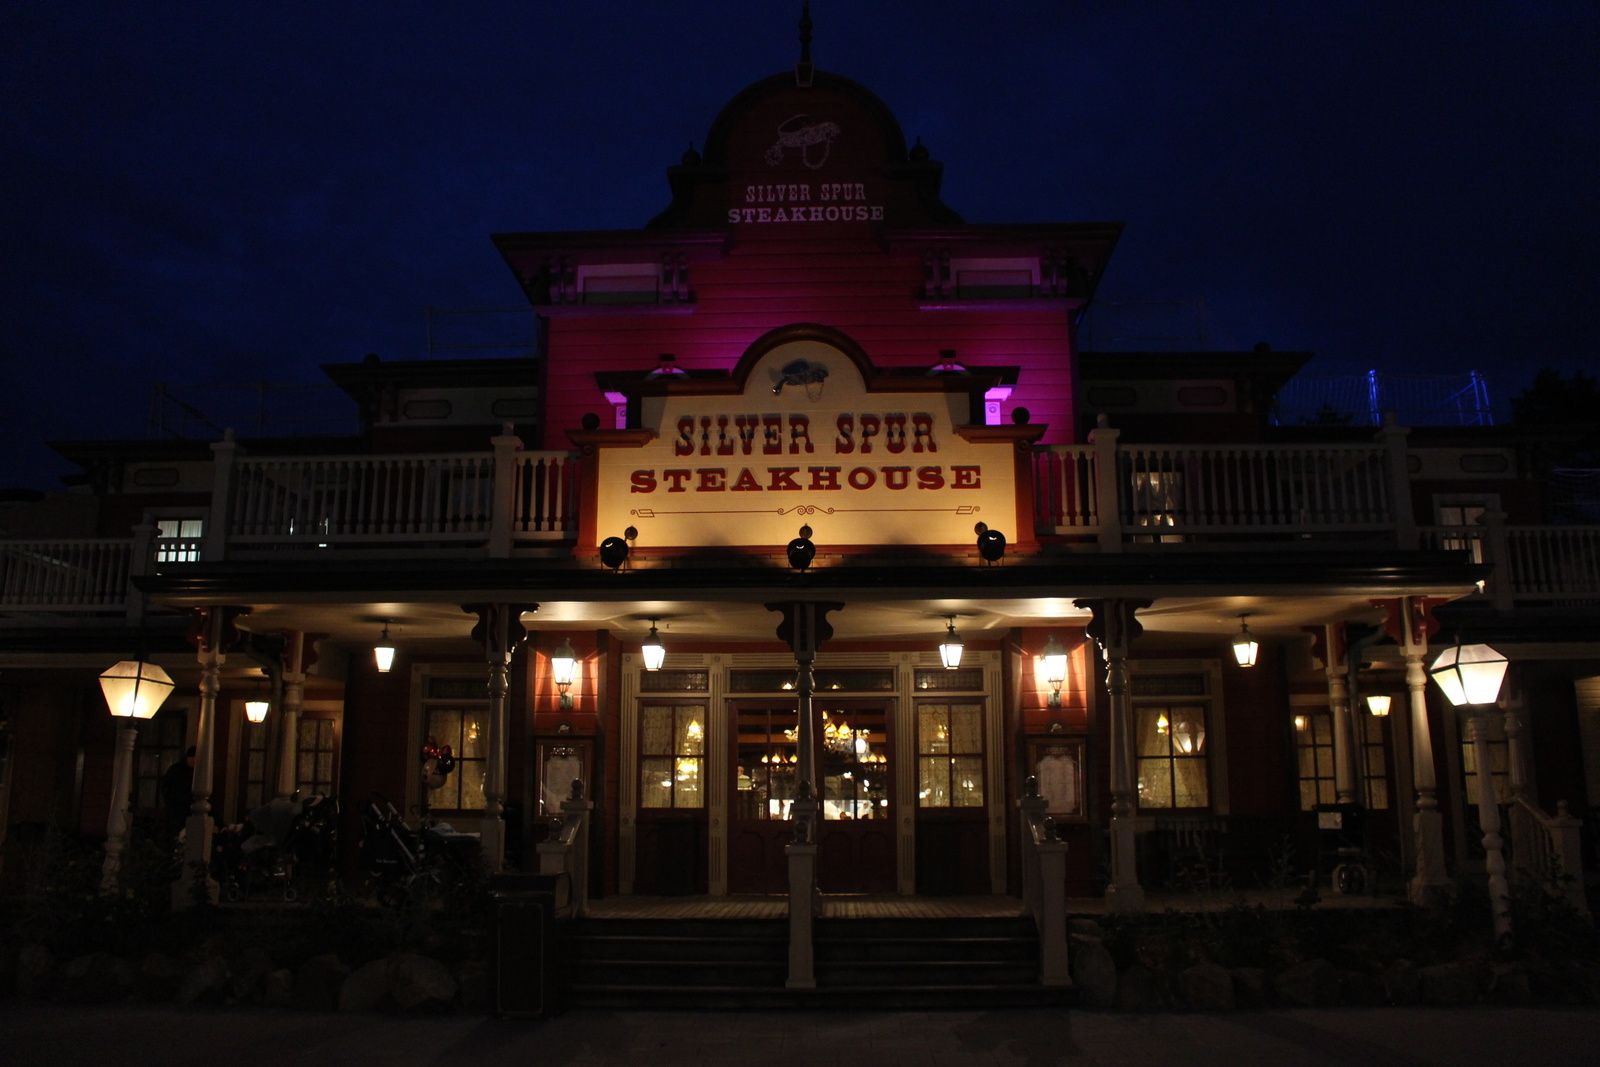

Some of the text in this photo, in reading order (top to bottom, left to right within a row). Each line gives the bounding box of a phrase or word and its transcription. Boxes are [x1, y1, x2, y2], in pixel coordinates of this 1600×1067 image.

[745, 183, 866, 202] SILVER SPUR
[727, 206, 884, 223] STEAKHOUSE
[674, 412, 938, 457] SILVER SPUR
[629, 465, 982, 494] STEAKHOUSE
